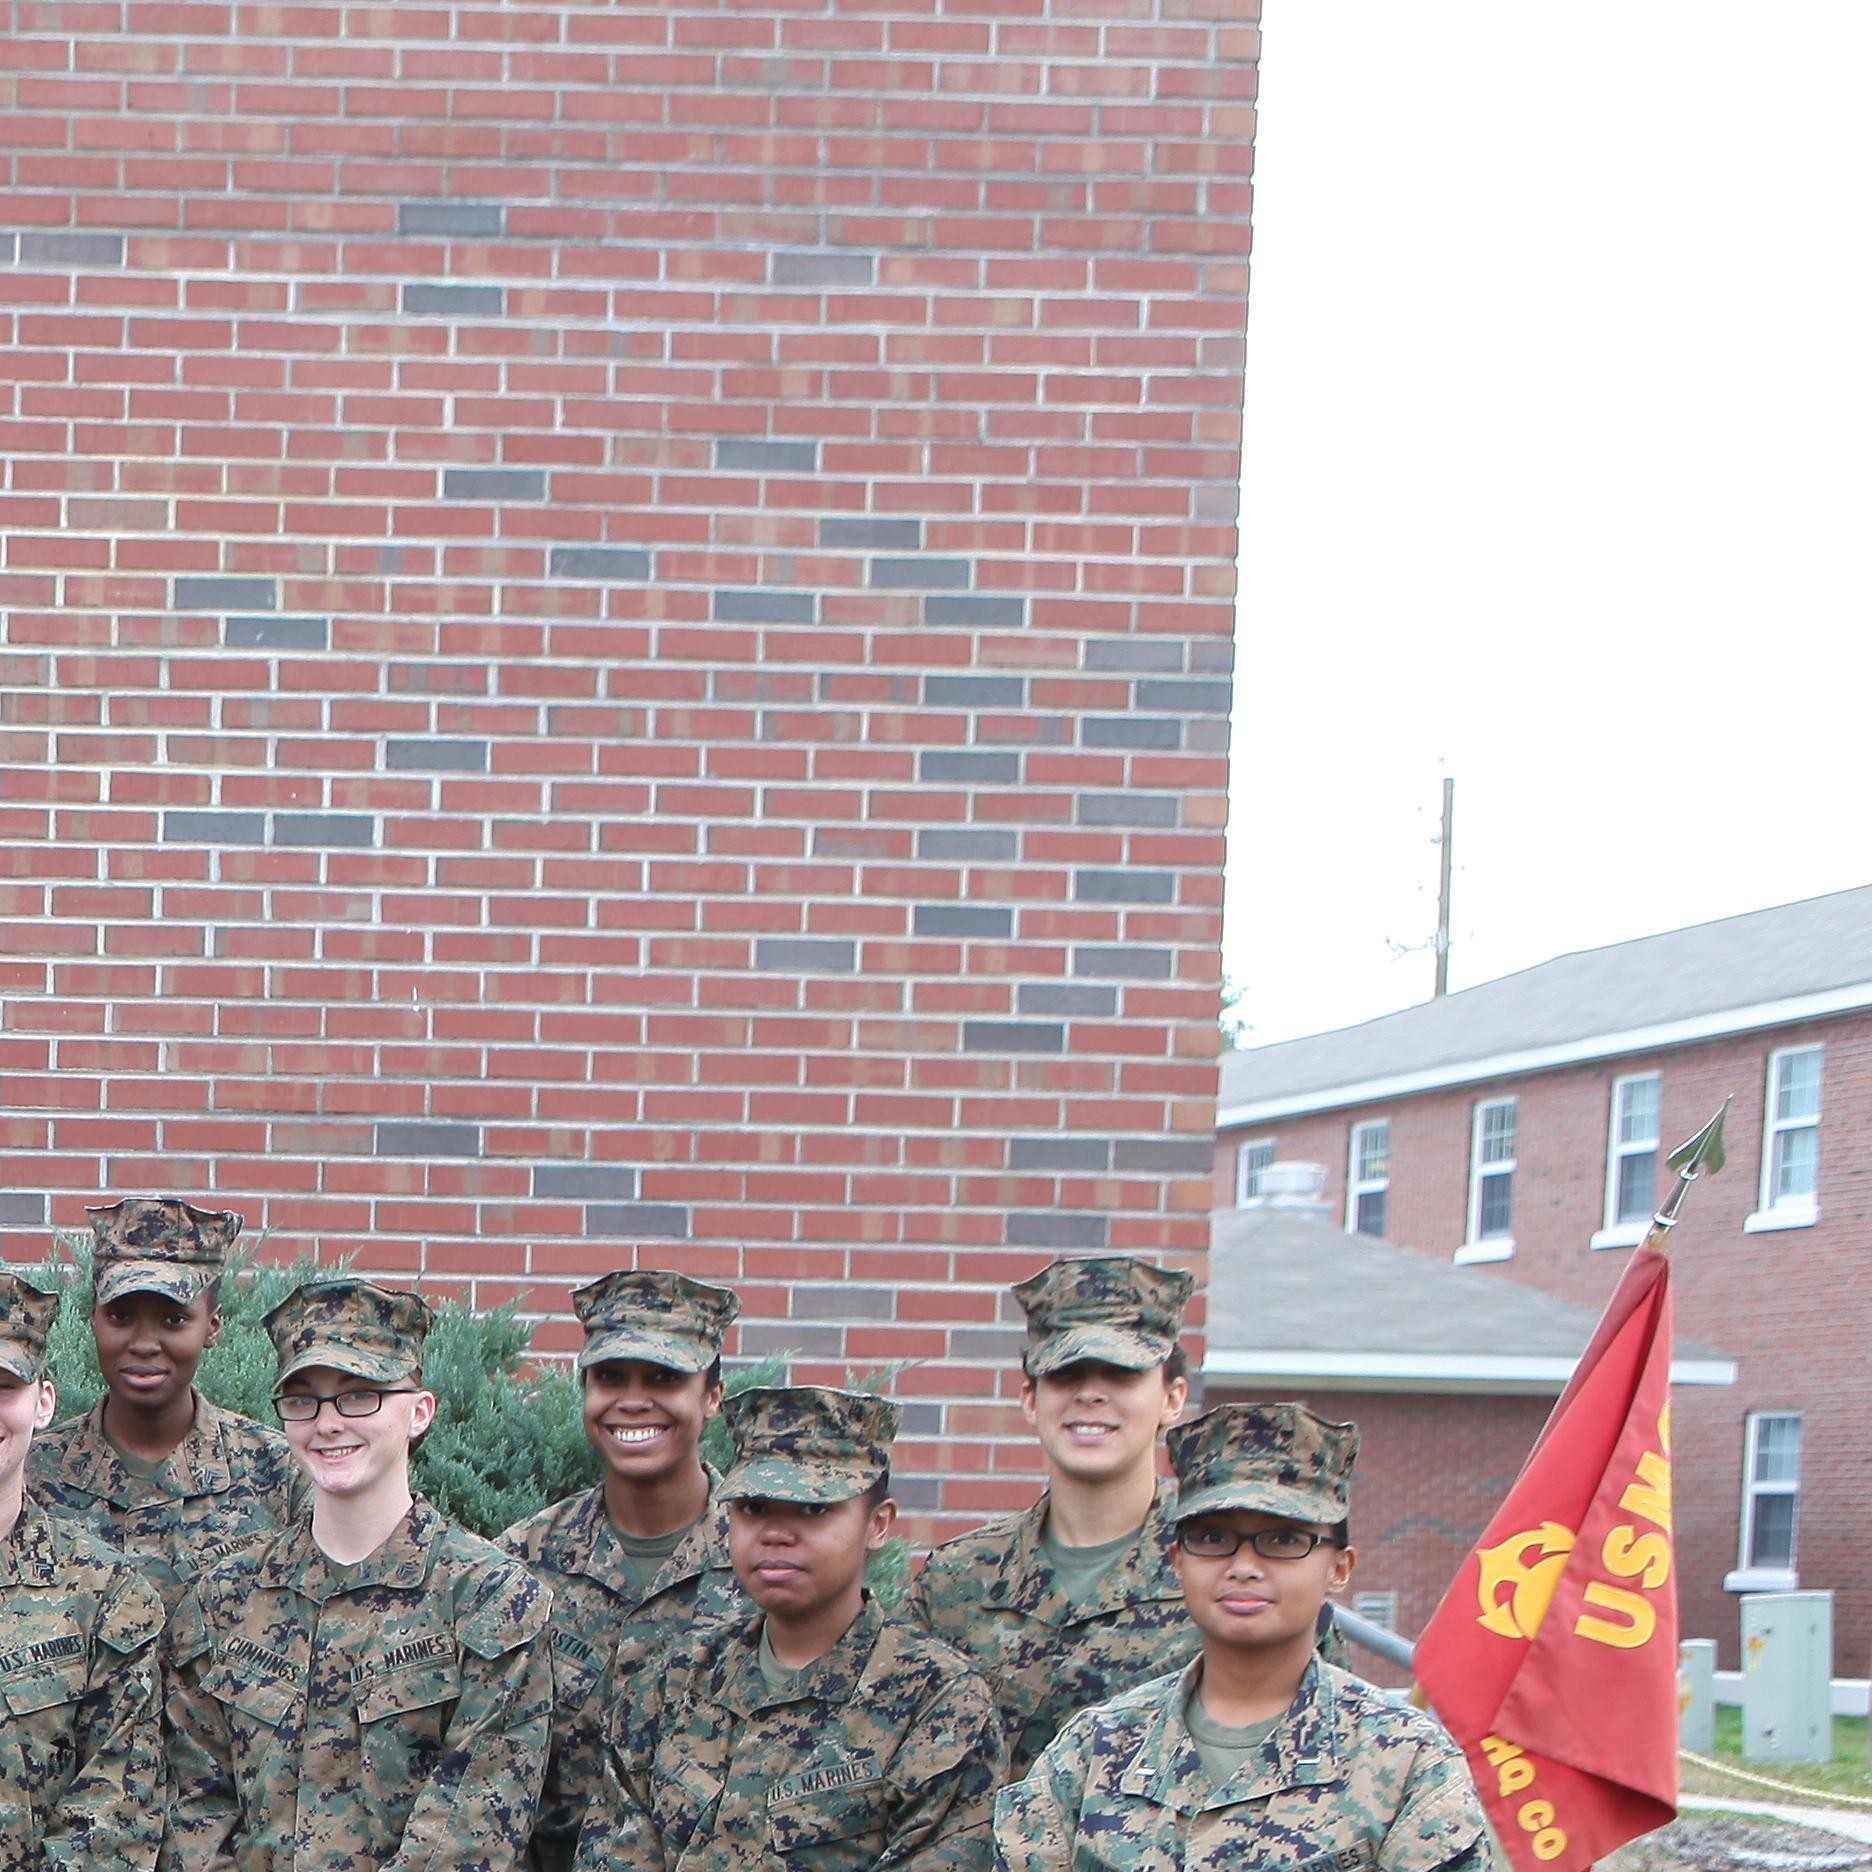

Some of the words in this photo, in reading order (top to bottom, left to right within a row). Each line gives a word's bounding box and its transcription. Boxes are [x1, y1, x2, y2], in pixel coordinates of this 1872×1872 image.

[1573, 1400, 1672, 1649] USM
[27, 1634, 82, 1662] MARINES
[227, 1637, 300, 1682] CUMMINGS
[383, 1635, 446, 1669] MARINES
[771, 1782, 798, 1802] U.S.
[798, 1762, 874, 1794] MARINES
[1479, 1734, 1536, 1798] HQ
[1516, 1798, 1568, 1861] CO
